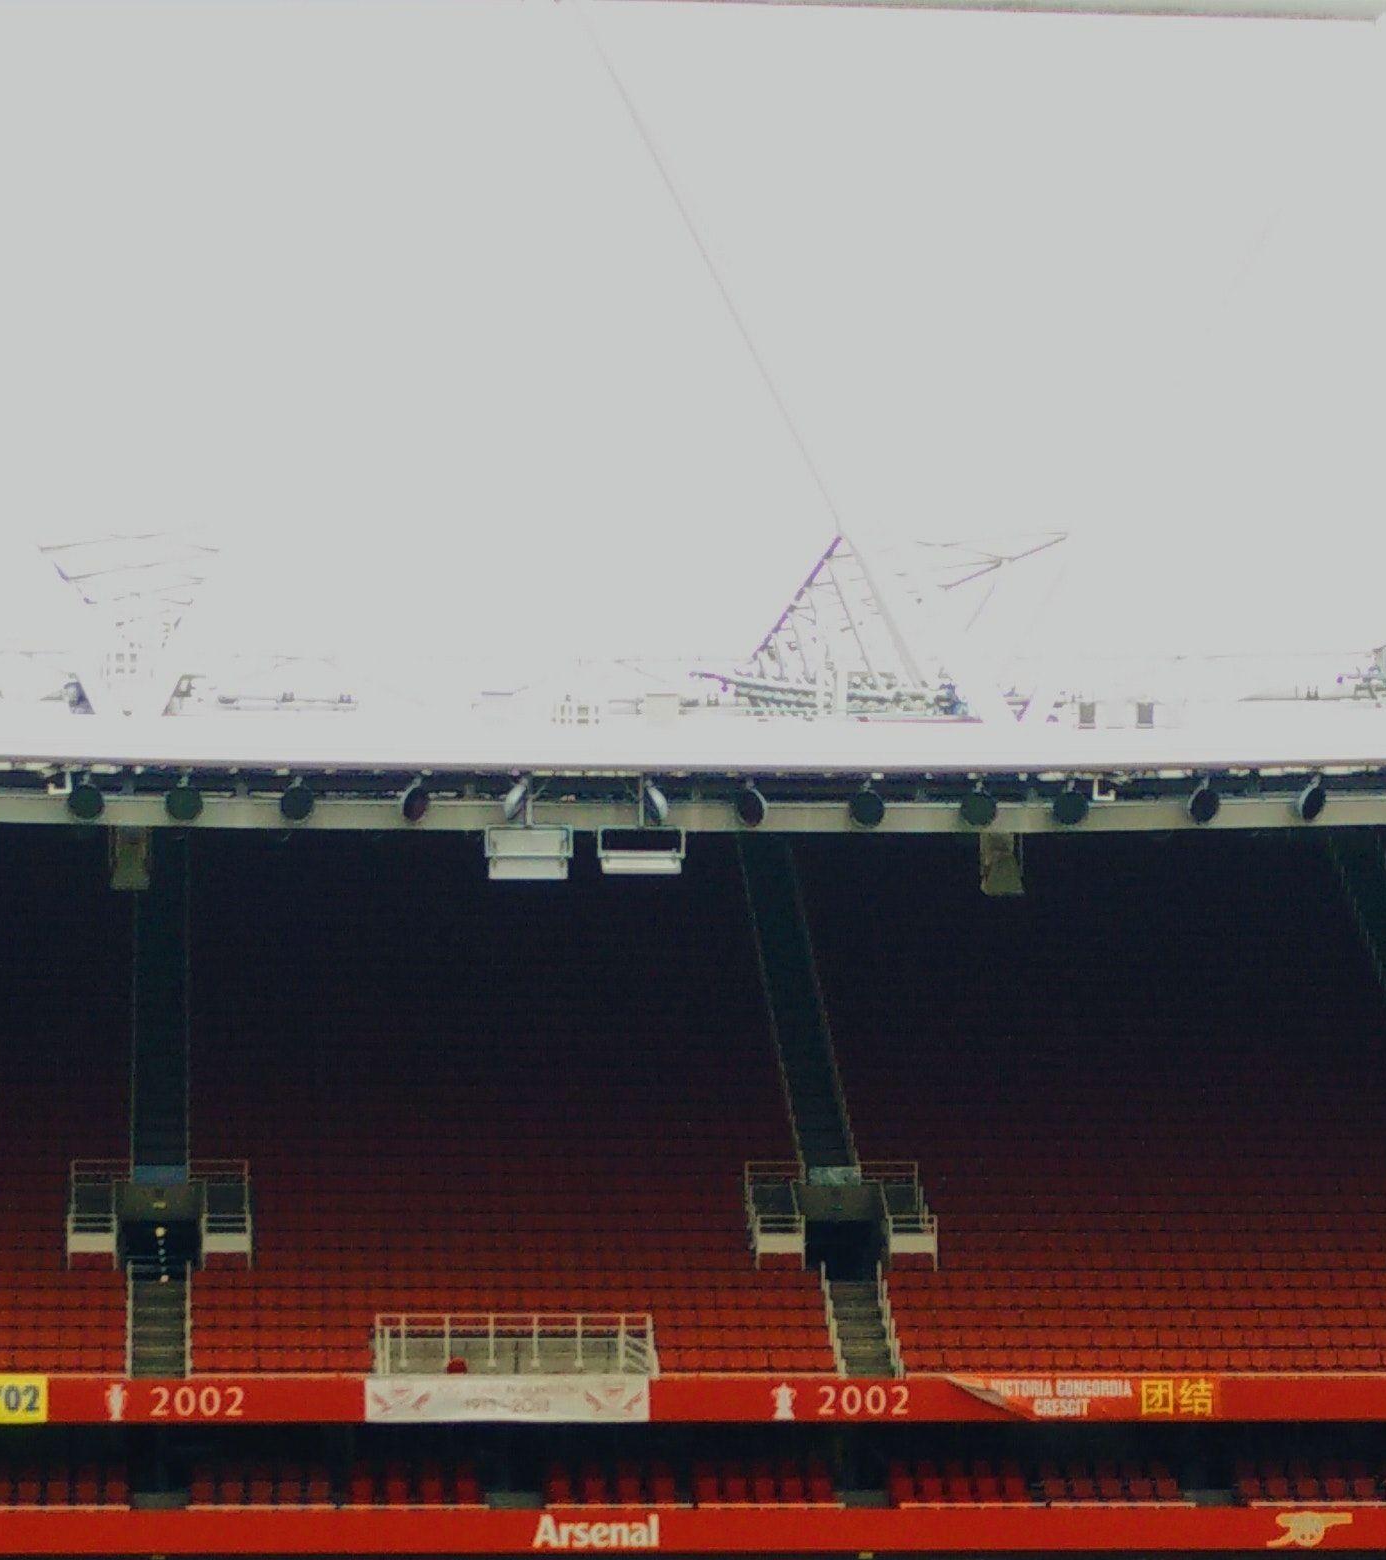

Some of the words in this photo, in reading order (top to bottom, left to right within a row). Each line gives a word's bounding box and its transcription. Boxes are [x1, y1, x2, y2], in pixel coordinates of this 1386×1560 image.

[149, 1386, 245, 1417] 2002
[817, 1385, 910, 1415] 2002
[1141, 1378, 1213, 1416] 团结
[532, 1513, 660, 1549] Arsenal
